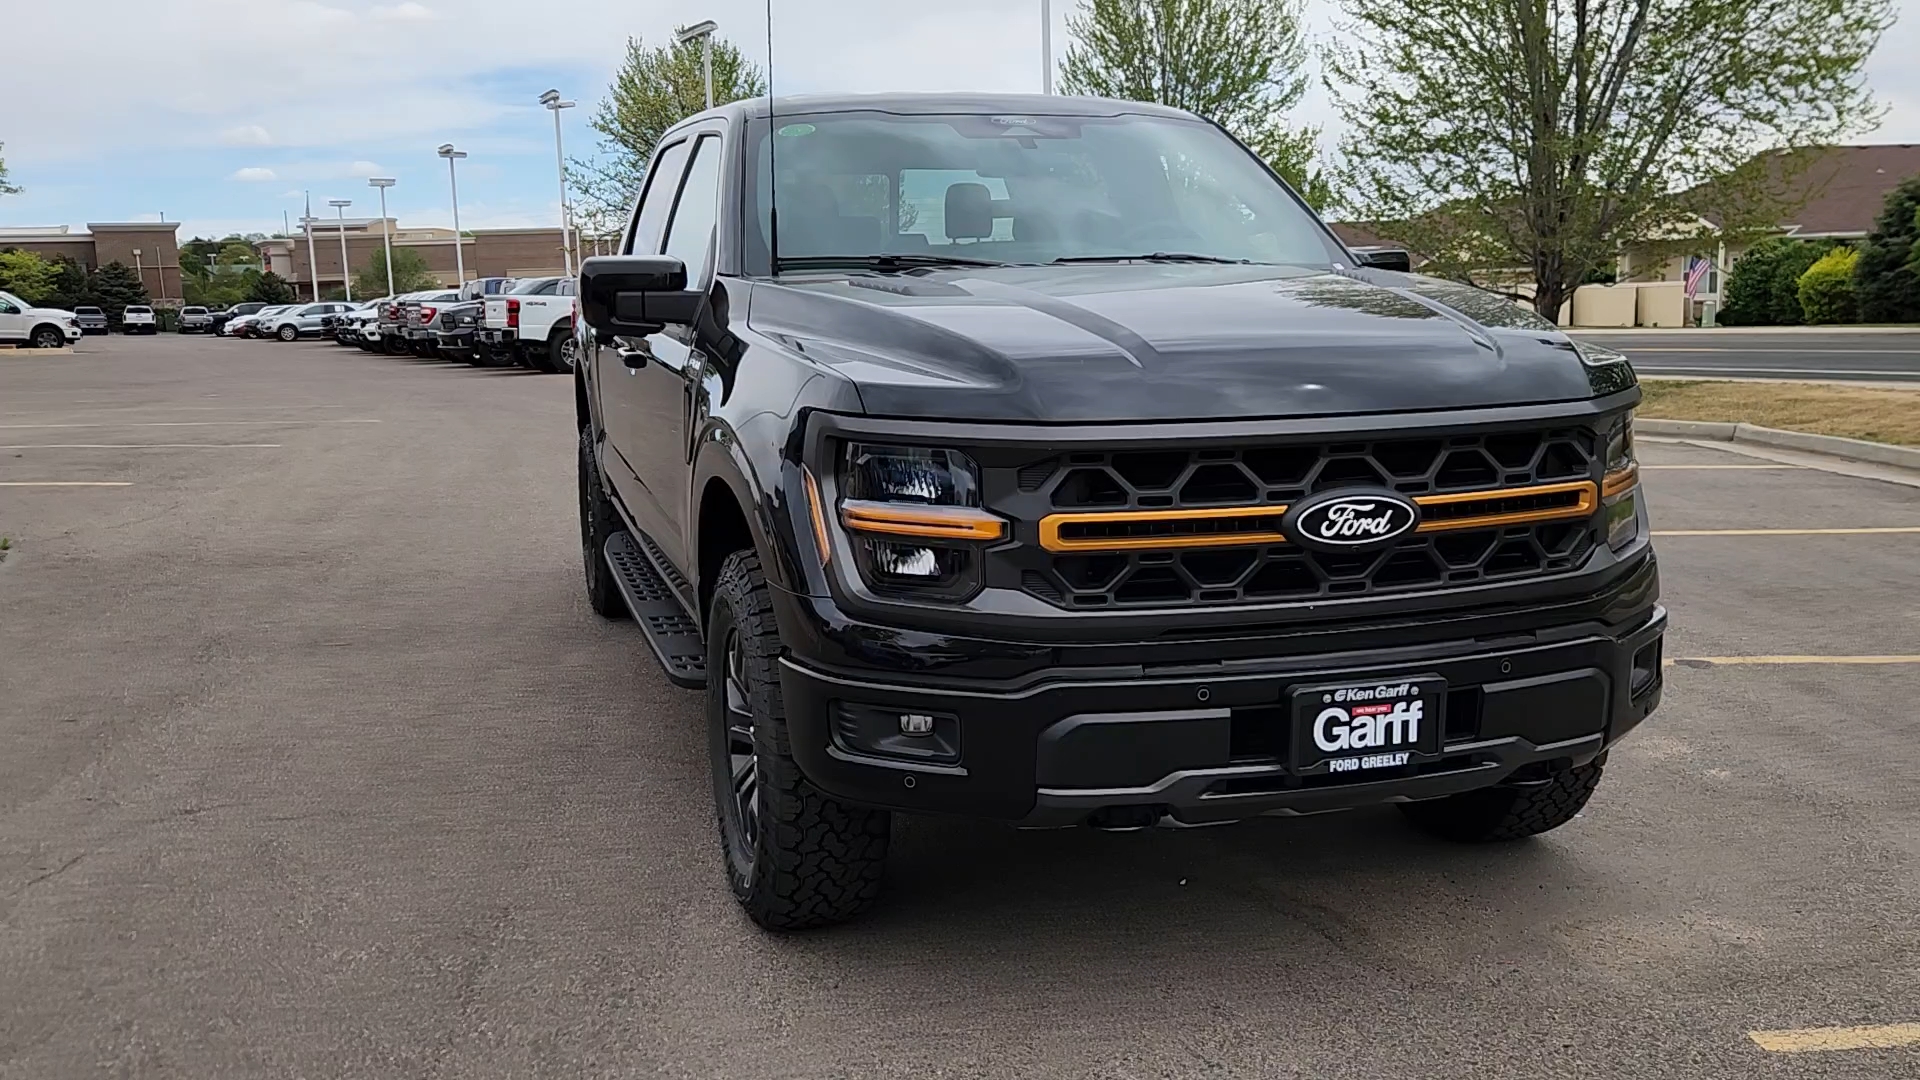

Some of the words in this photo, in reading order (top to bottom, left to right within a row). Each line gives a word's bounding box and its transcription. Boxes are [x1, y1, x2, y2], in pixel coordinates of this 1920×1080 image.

[1320, 503, 1393, 537] Ford
[1346, 688, 1374, 701] Ken
[1375, 683, 1410, 698] Garff
[1313, 700, 1423, 752] Garff
[1329, 757, 1360, 772] FORD
[1361, 752, 1410, 769] GREELEY
